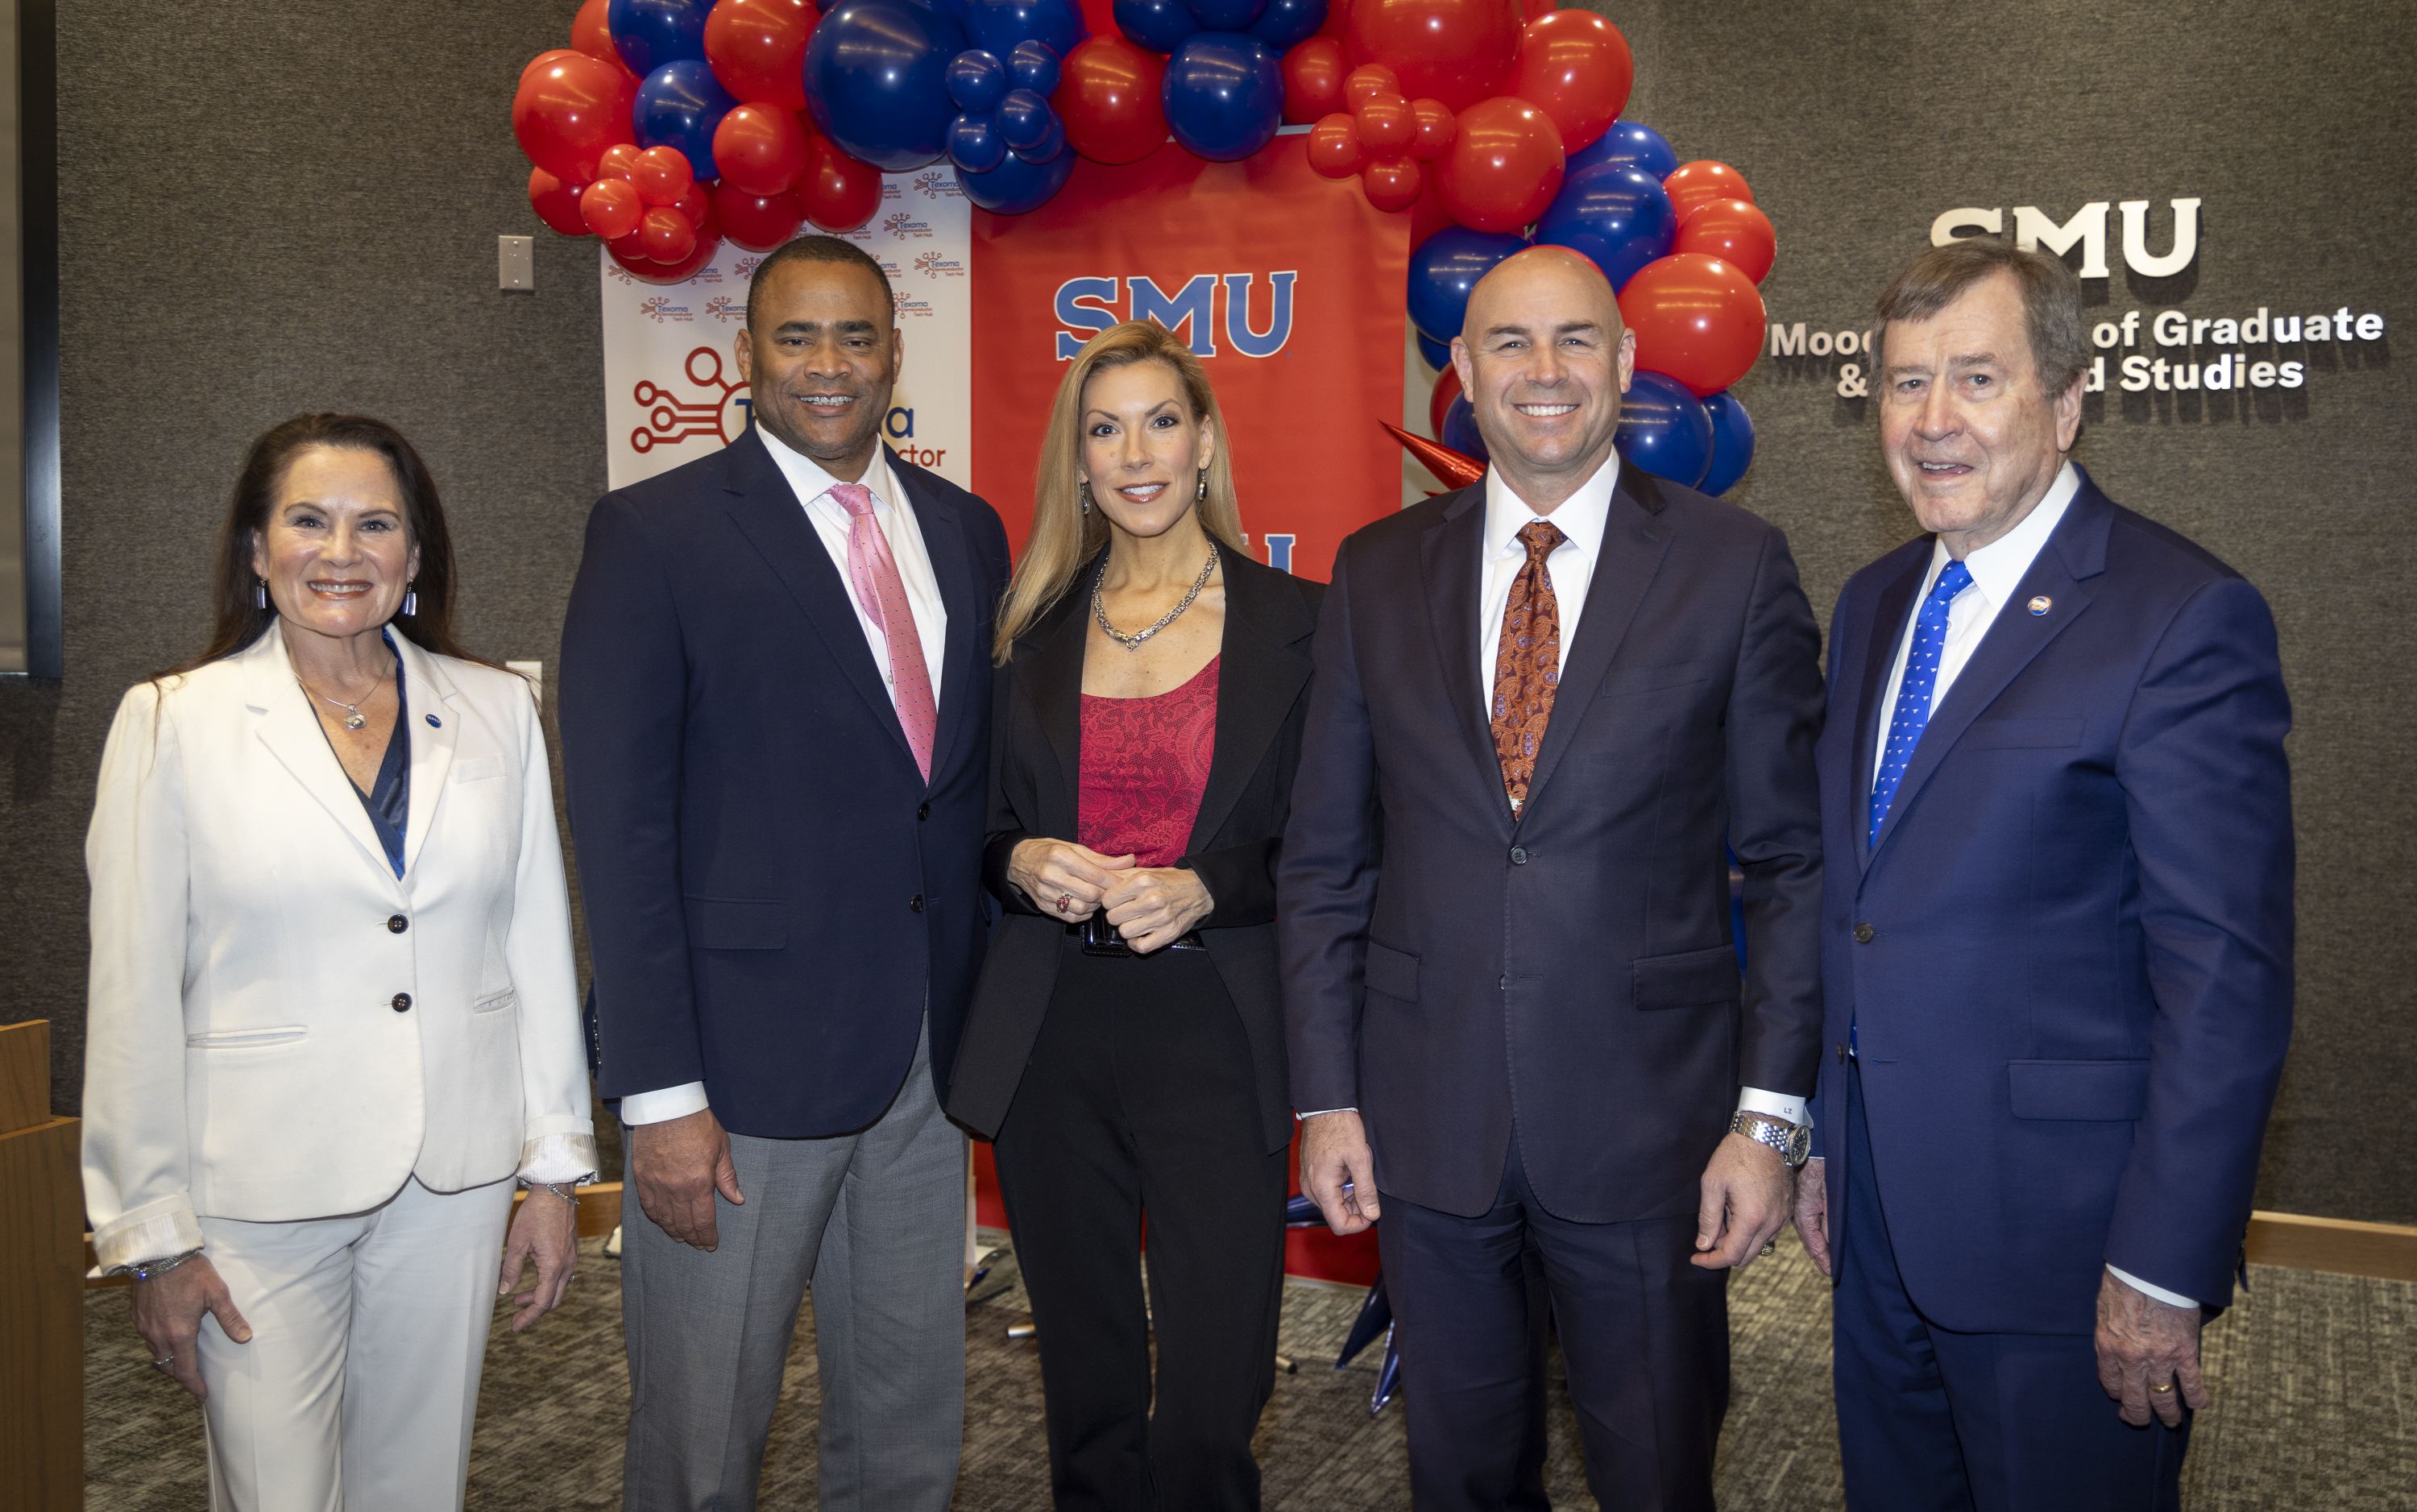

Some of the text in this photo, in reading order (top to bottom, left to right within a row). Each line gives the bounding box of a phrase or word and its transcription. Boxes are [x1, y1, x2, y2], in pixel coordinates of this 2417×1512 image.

[931, 180, 960, 188] Texoma
[899, 222, 927, 230] Texoma
[931, 260, 960, 268] Texoma
[900, 300, 928, 309] Texoma
[1054, 271, 1297, 361] SMU
[1772, 307, 2385, 357] Moo of Graduate
[1837, 363, 1868, 398] &
[2120, 354, 2304, 391] Studies
[427, 715, 441, 723] SMU
